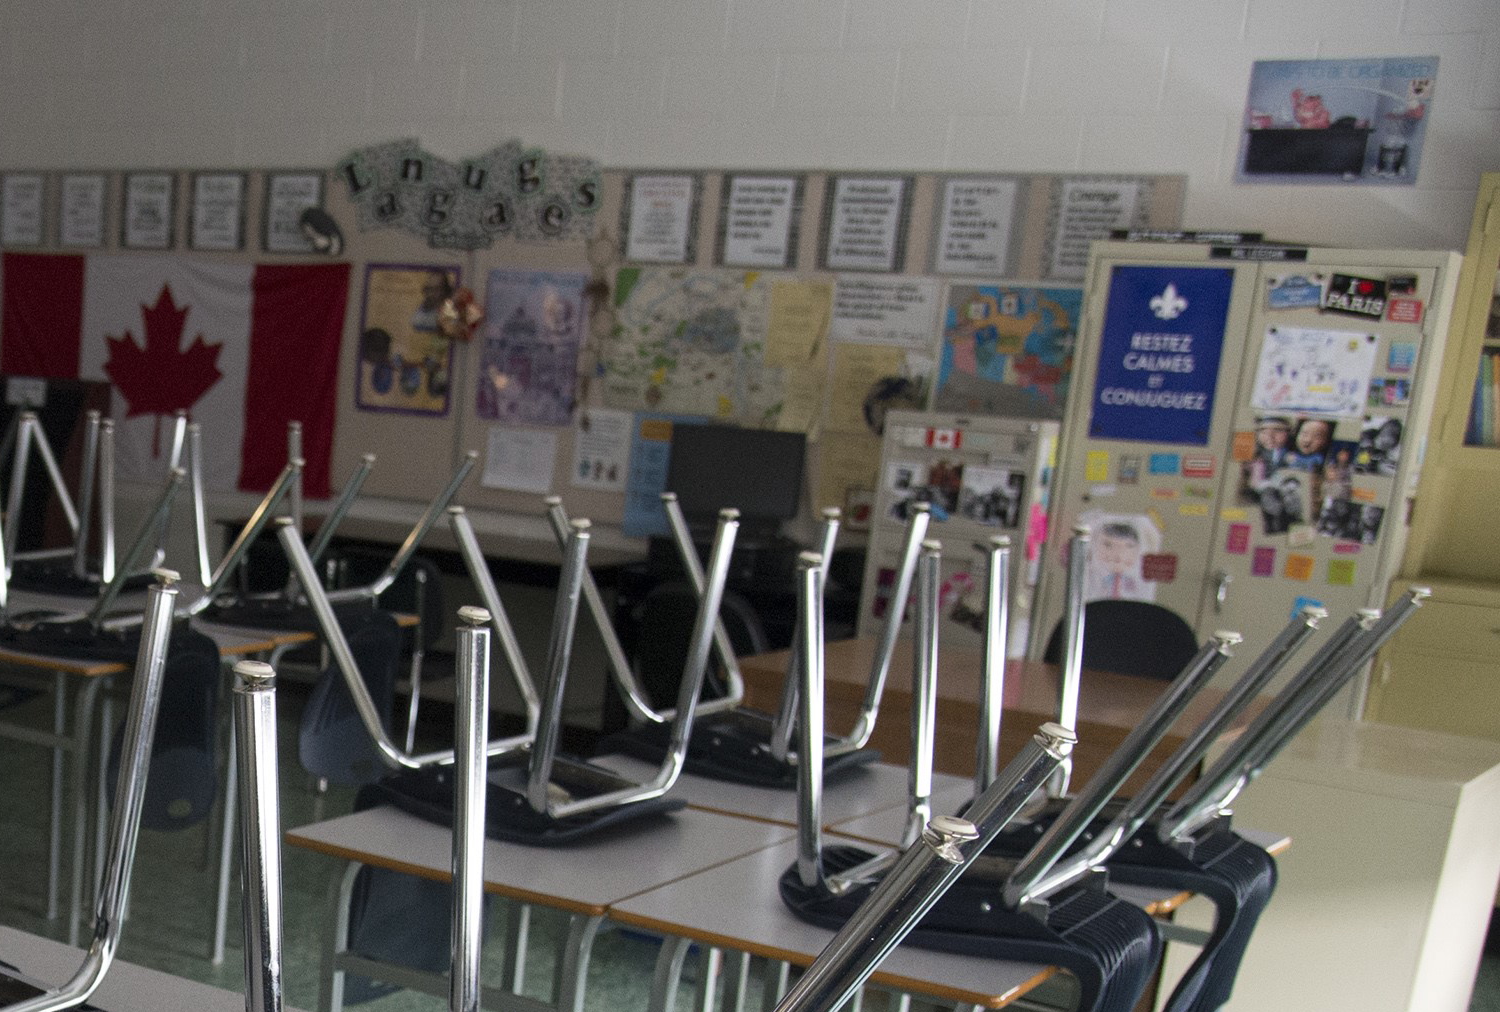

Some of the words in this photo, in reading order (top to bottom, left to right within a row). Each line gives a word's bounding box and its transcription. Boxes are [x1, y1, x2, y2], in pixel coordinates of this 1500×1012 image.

[1326, 292, 1384, 316] PARIS
[1130, 332, 1193, 353] RESTEZ
[1122, 352, 1195, 374] CALMES
[1147, 374, 1164, 389] ET
[1100, 387, 1208, 411] CONJUGUEZ
